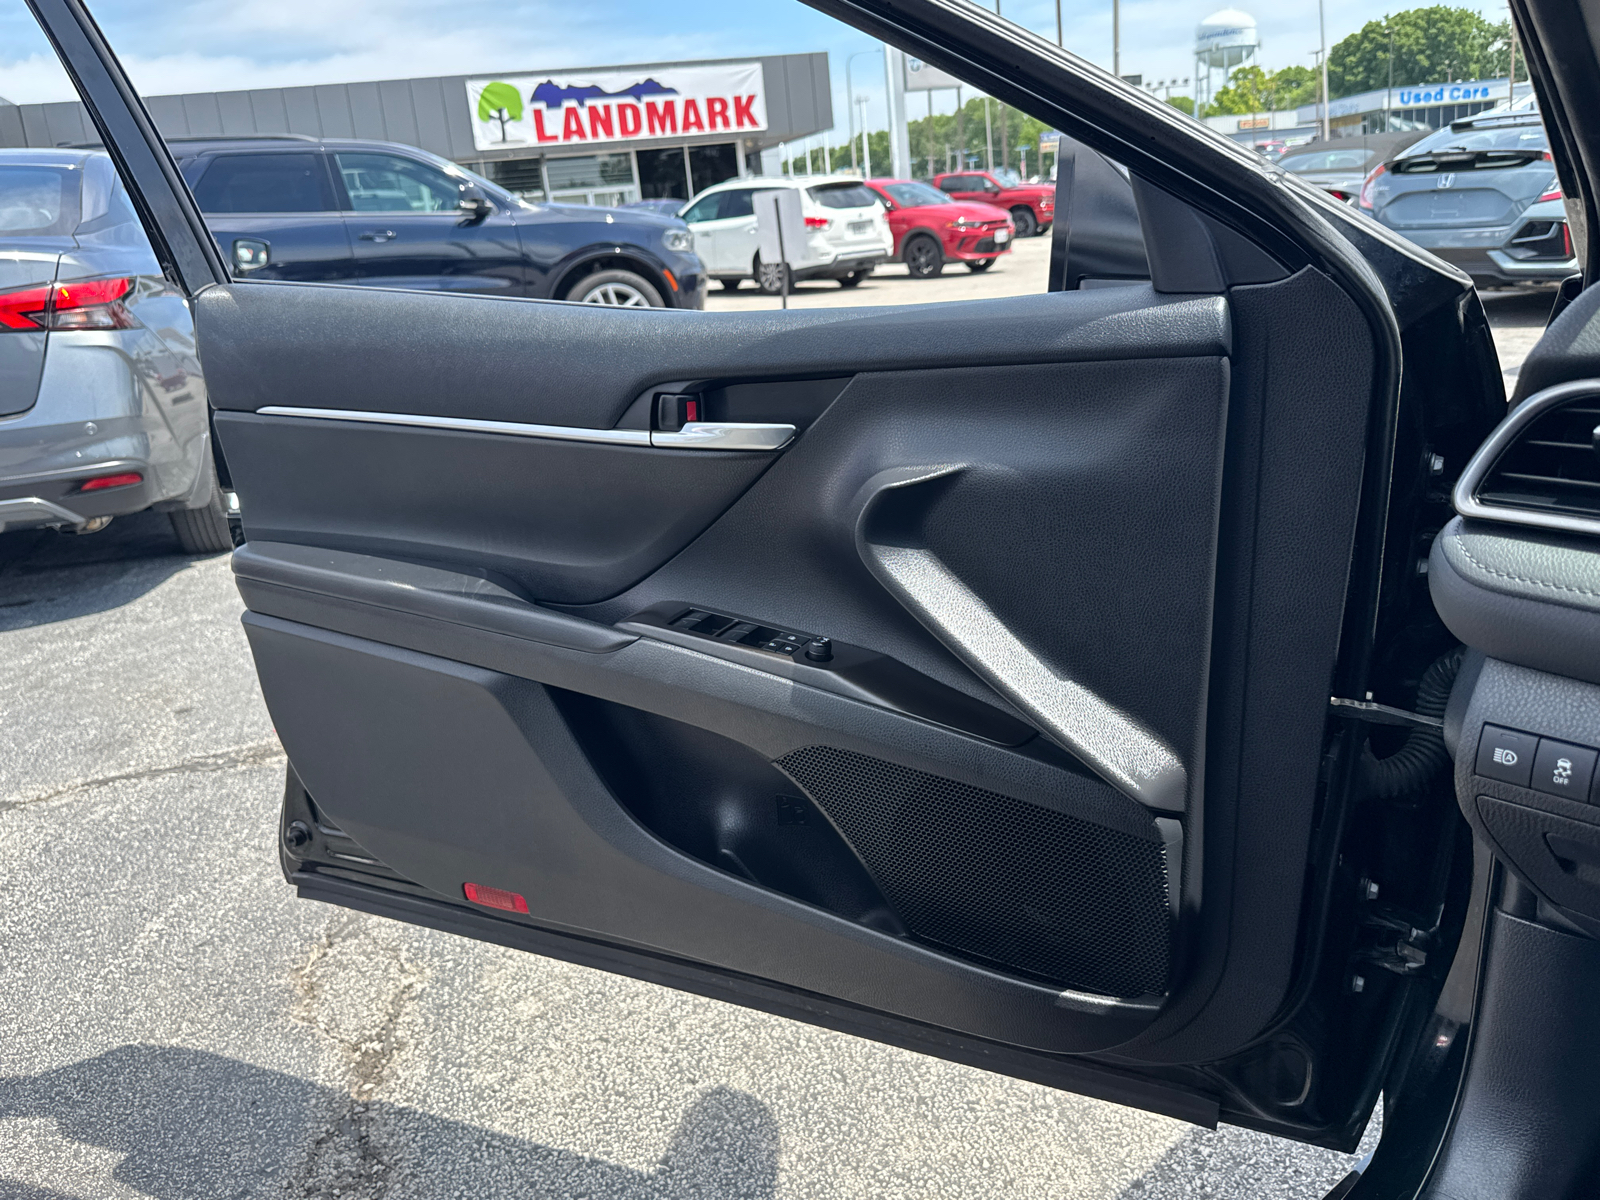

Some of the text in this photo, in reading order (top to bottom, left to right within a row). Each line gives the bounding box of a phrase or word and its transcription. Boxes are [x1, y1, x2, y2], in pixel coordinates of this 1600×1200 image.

[1400, 87, 1489, 105] Used Cars
[532, 94, 760, 143] LANDMARK
[1553, 775, 1569, 785] OFF
